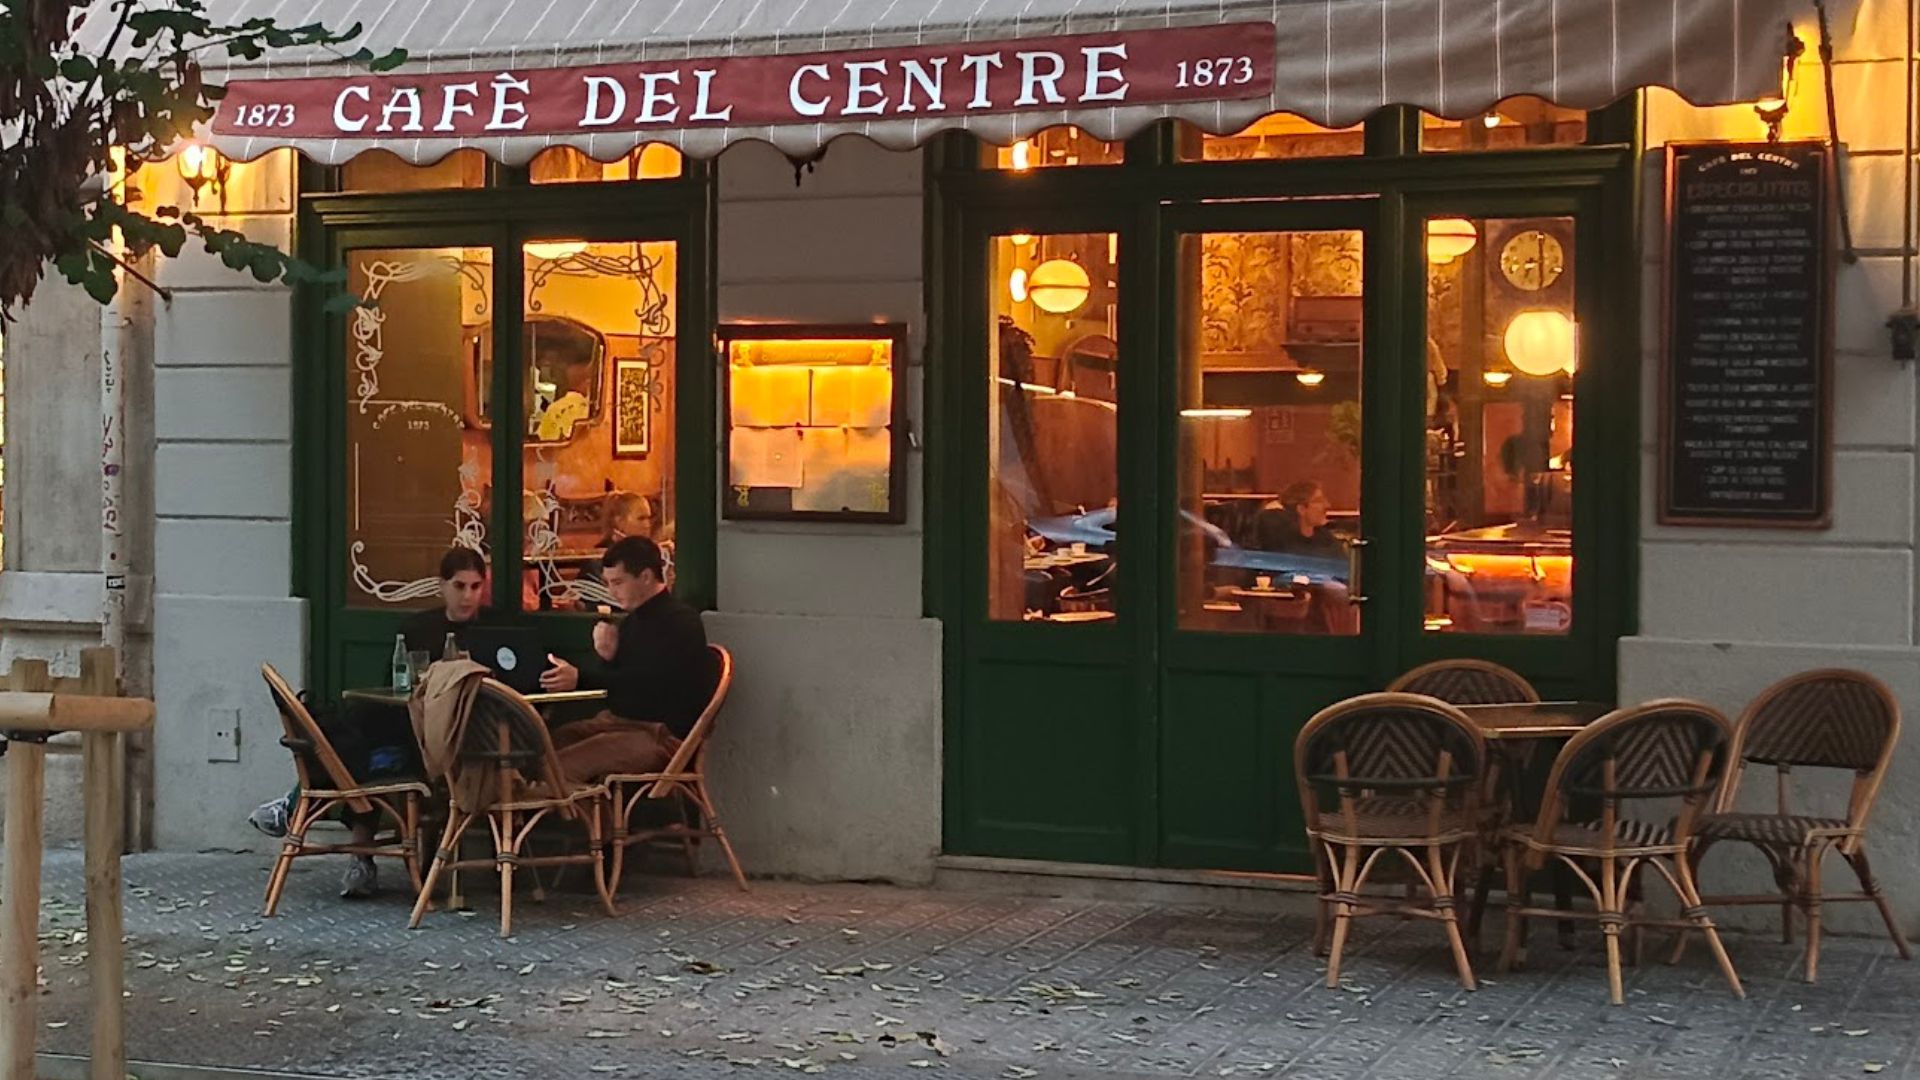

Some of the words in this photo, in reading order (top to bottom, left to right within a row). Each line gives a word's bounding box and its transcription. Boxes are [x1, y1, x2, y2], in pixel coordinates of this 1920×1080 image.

[233, 102, 296, 129] 1873
[578, 69, 732, 126] DEL
[788, 42, 1131, 117] CENTRE
[1175, 56, 1254, 89] 1873
